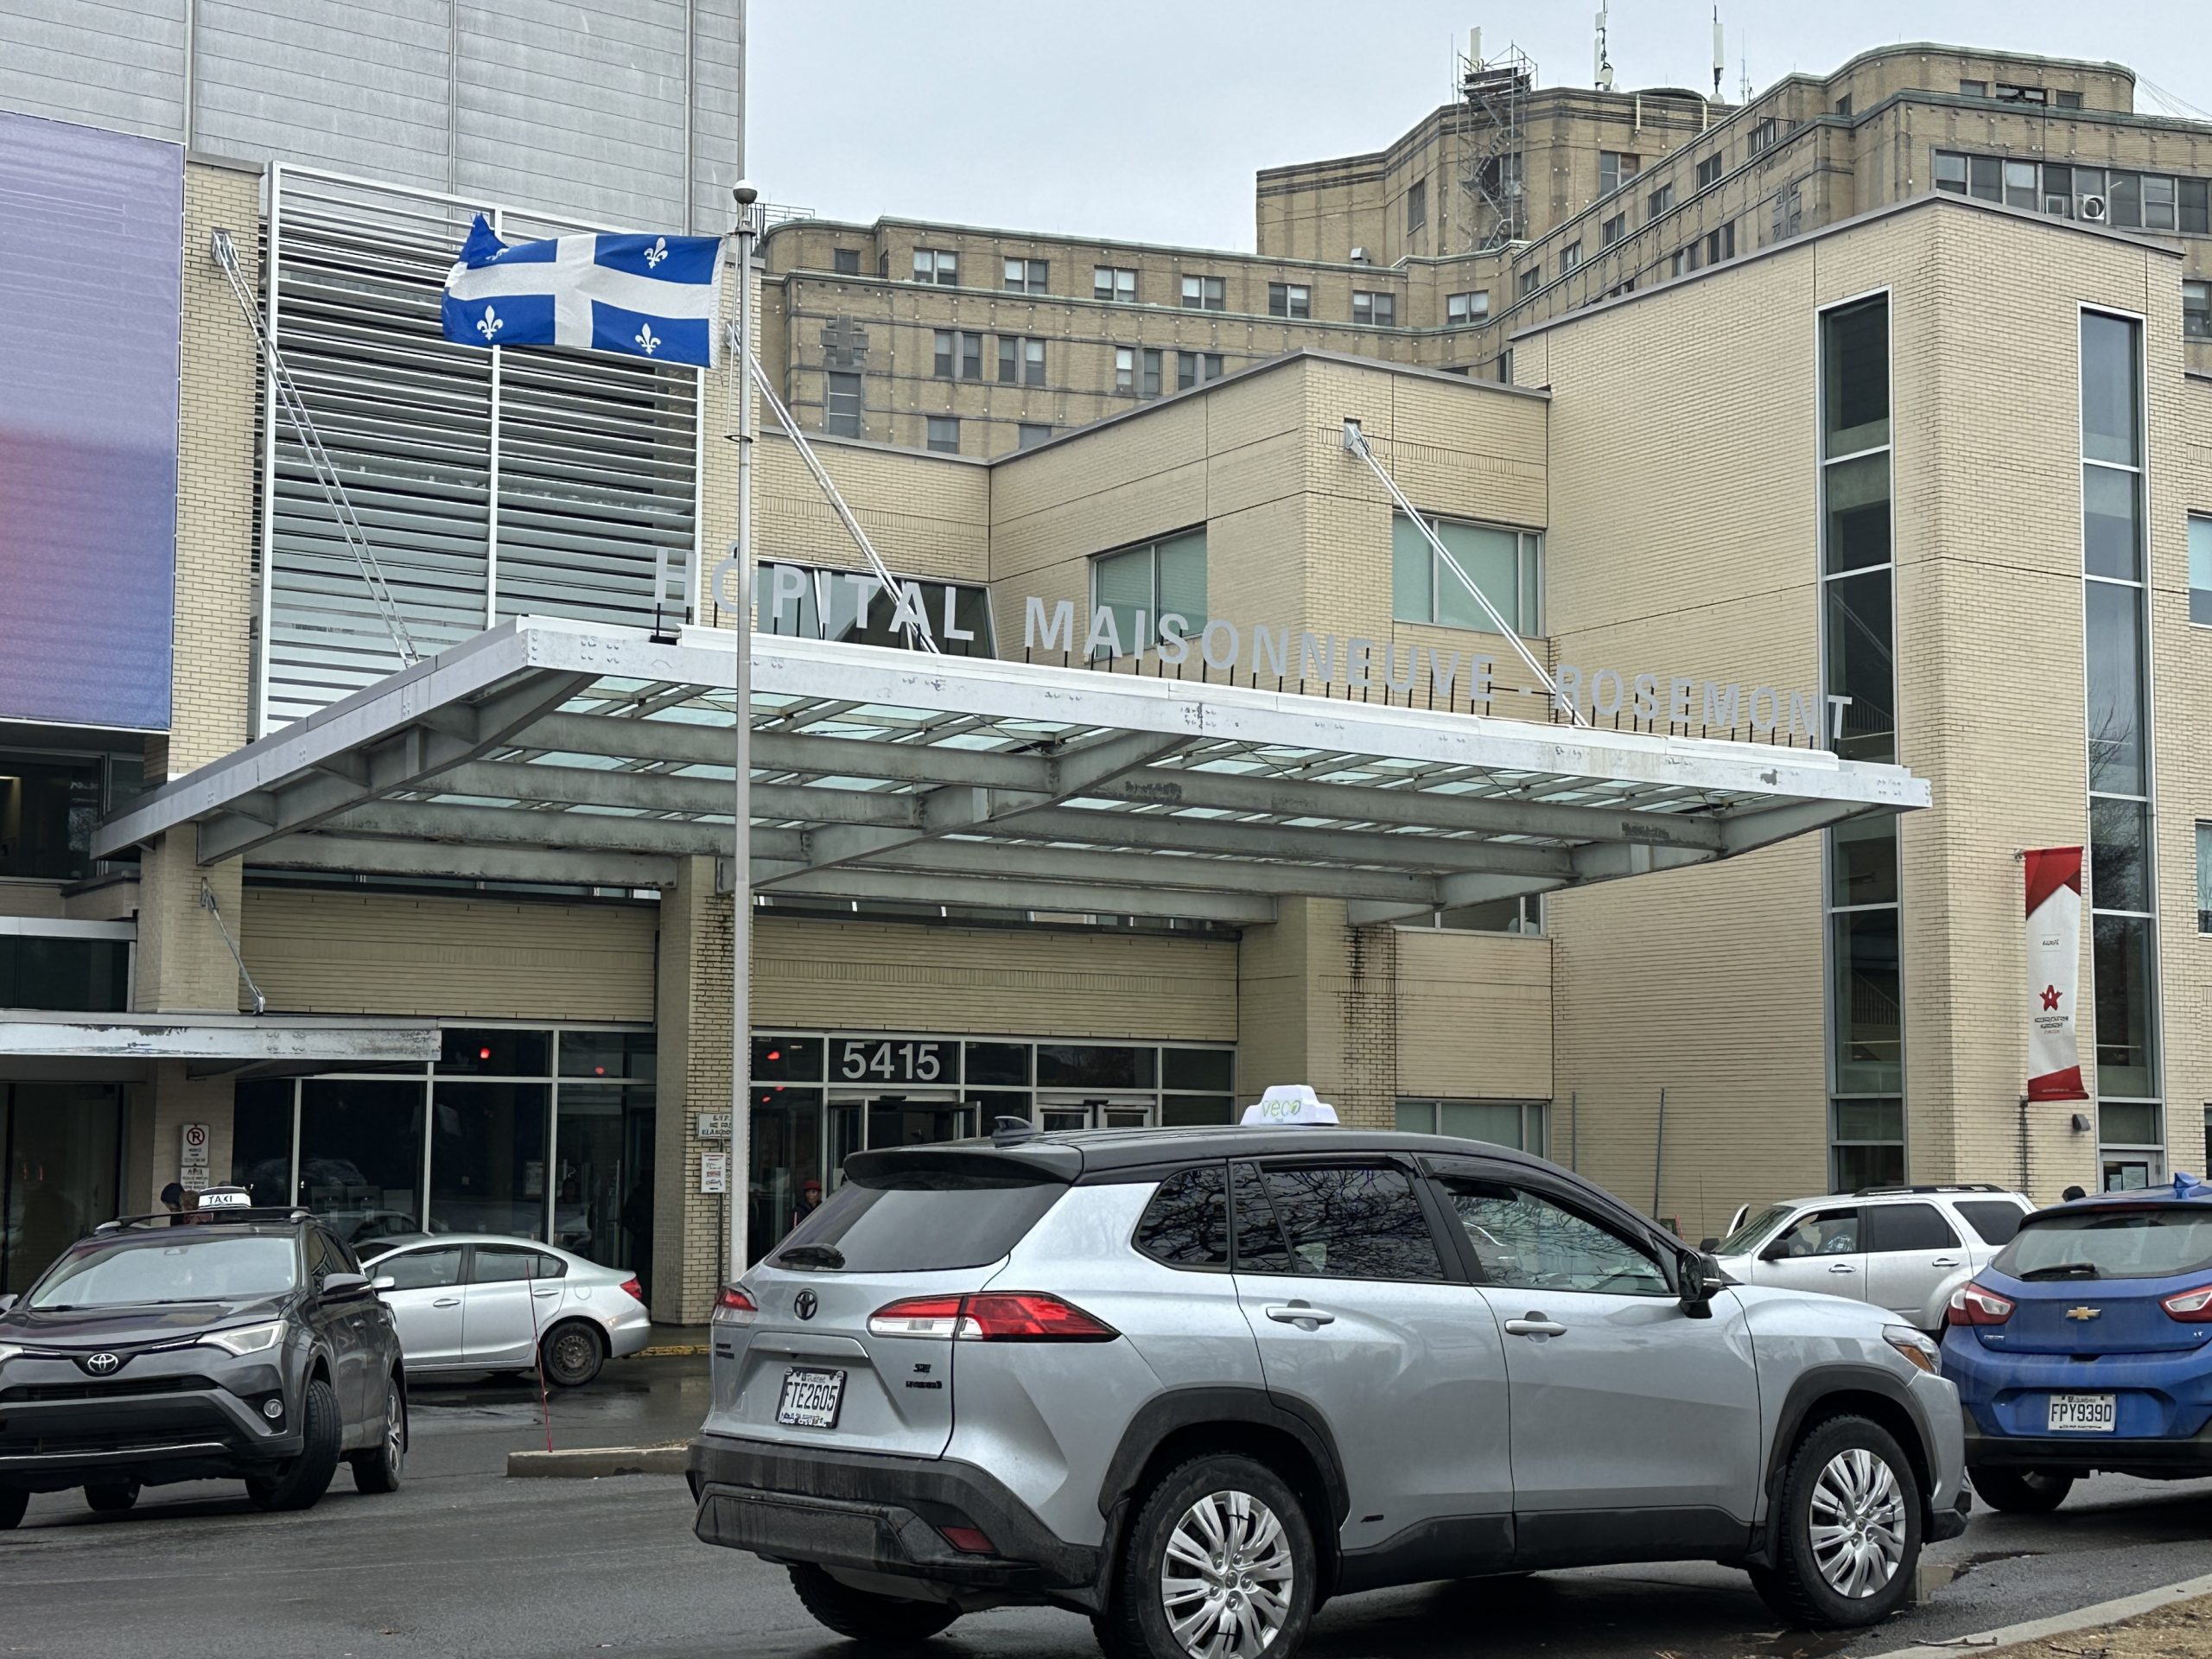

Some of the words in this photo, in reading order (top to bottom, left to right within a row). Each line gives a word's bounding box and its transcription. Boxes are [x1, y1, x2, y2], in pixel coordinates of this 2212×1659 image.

[1025, 595, 1493, 700] MAISONNEUVE
[1554, 664, 1853, 740] ROSEMONT
[842, 1041, 940, 1081] 5415
[208, 1195, 232, 1204] TAXI
[782, 1381, 839, 1412] FTE2605
